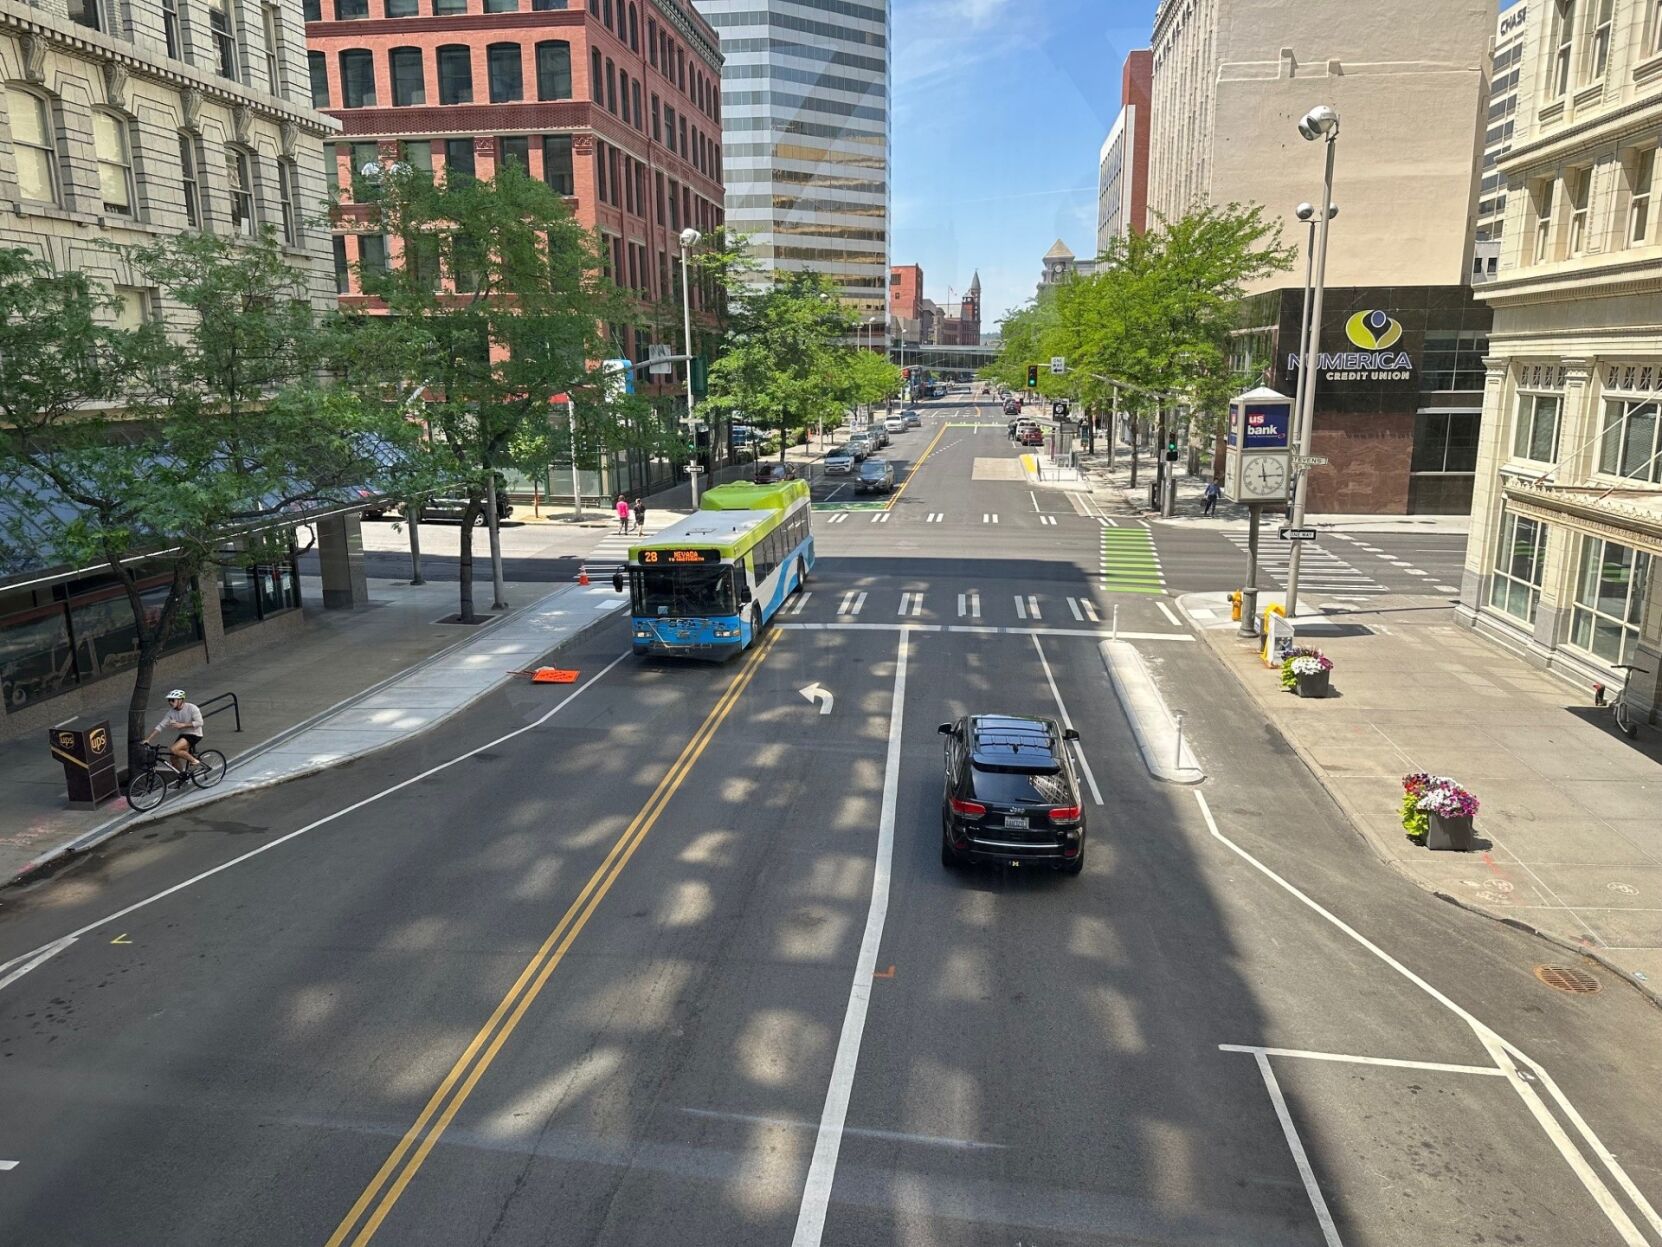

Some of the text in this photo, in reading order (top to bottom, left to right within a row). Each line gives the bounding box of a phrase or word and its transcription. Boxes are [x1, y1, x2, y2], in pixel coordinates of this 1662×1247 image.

[1288, 352, 1412, 370] NMERICA
[1326, 371, 1410, 380] CREDIT UNION
[1247, 424, 1278, 435] bank
[644, 551, 658, 563] 28
[92, 735, 106, 751] ups
[1010, 806, 1025, 814] Jeep
